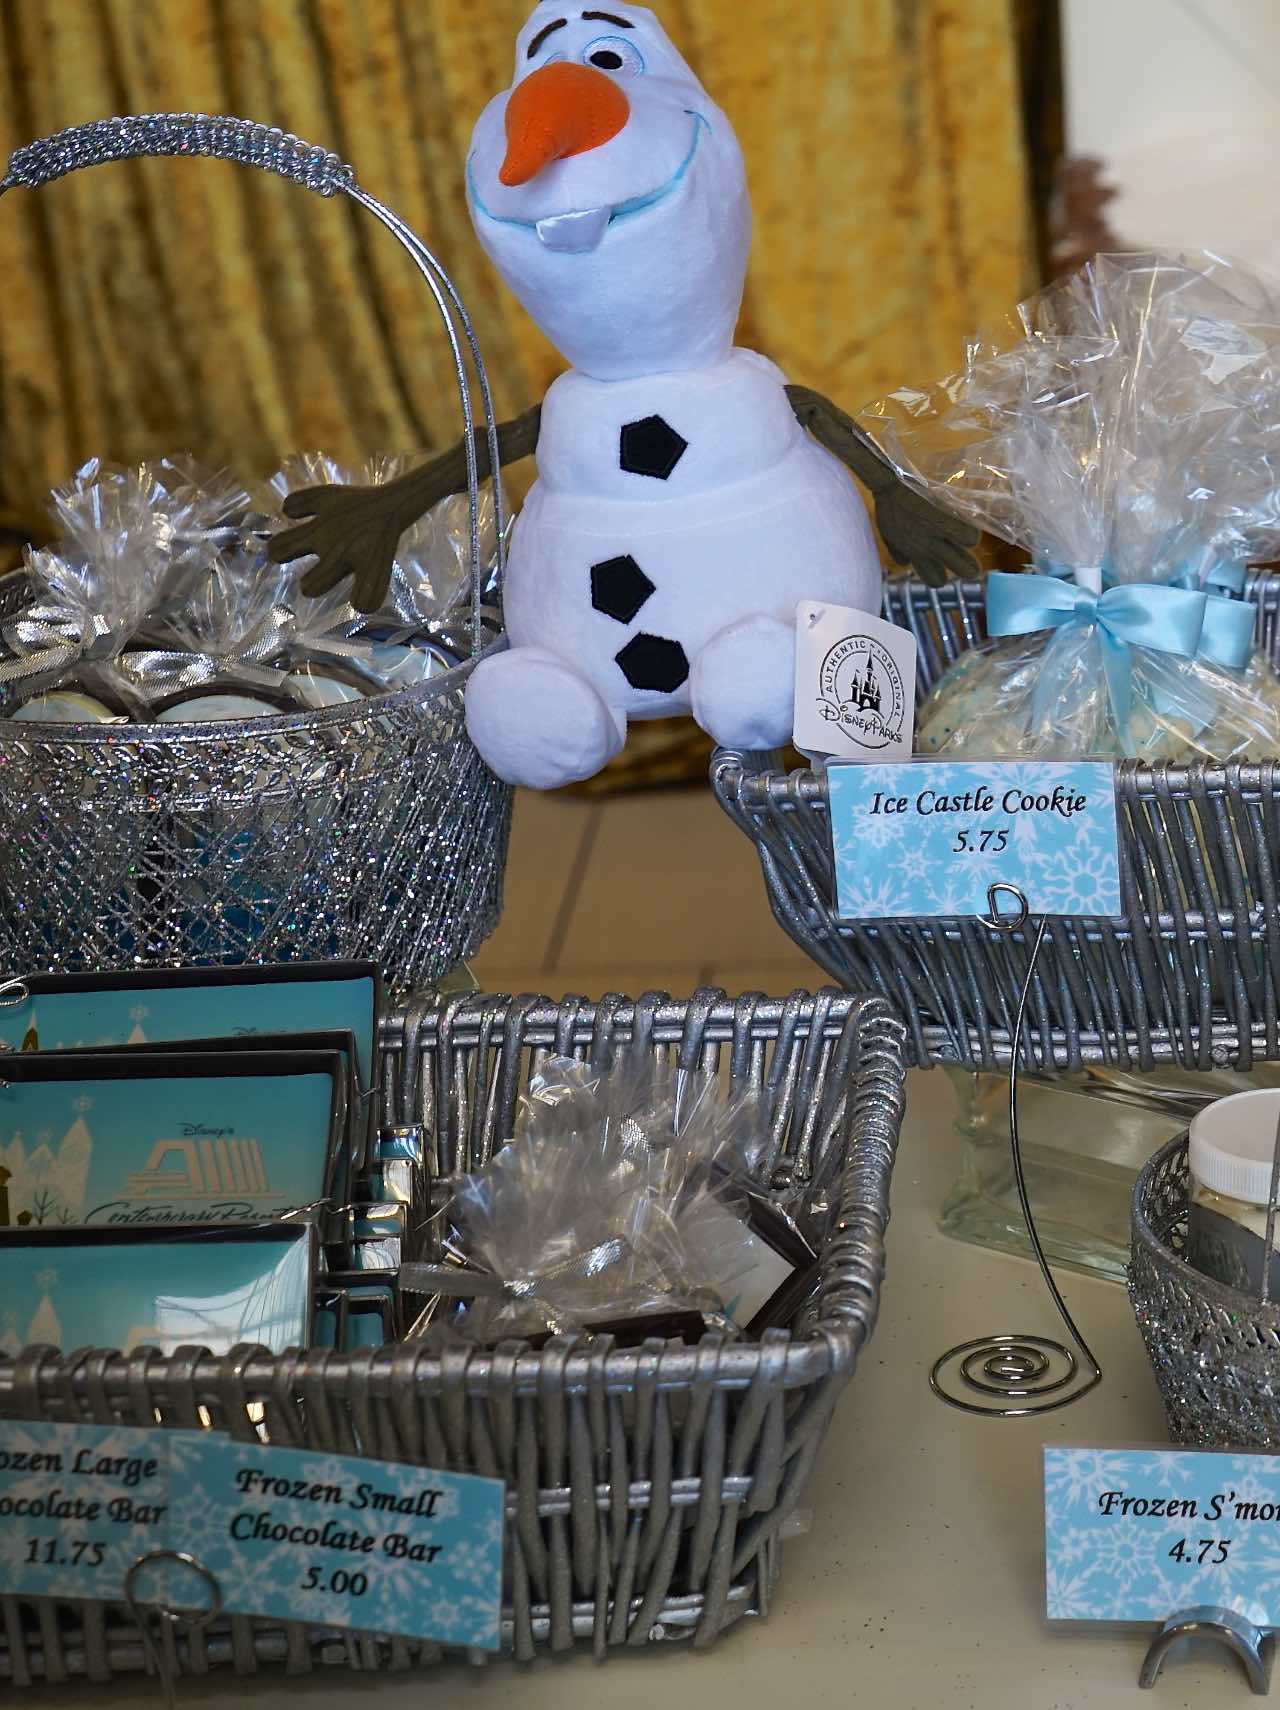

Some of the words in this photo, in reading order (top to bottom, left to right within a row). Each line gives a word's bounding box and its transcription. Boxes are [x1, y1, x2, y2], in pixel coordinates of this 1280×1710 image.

[825, 640, 866, 693] AUTHENTIC
[880, 653, 902, 717] ORIGINAL
[870, 792, 907, 815] Ice
[917, 786, 993, 815] Castle
[1002, 786, 1087, 817] Cookie
[952, 829, 1010, 852] 5.75
[0, 1450, 62, 1474] ozen
[72, 1449, 159, 1486] Large
[0, 1490, 100, 1521] ocolate
[107, 1497, 168, 1525] Bar
[235, 1468, 343, 1504] Frozen
[350, 1483, 444, 1518] Small
[1098, 1491, 1198, 1518] Frozen
[24, 1538, 107, 1567] 11.75
[229, 1512, 375, 1553] Chocolate
[382, 1532, 443, 1563] Bar
[1168, 1538, 1232, 1564] 4.75
[301, 1566, 369, 1596] 5.00
